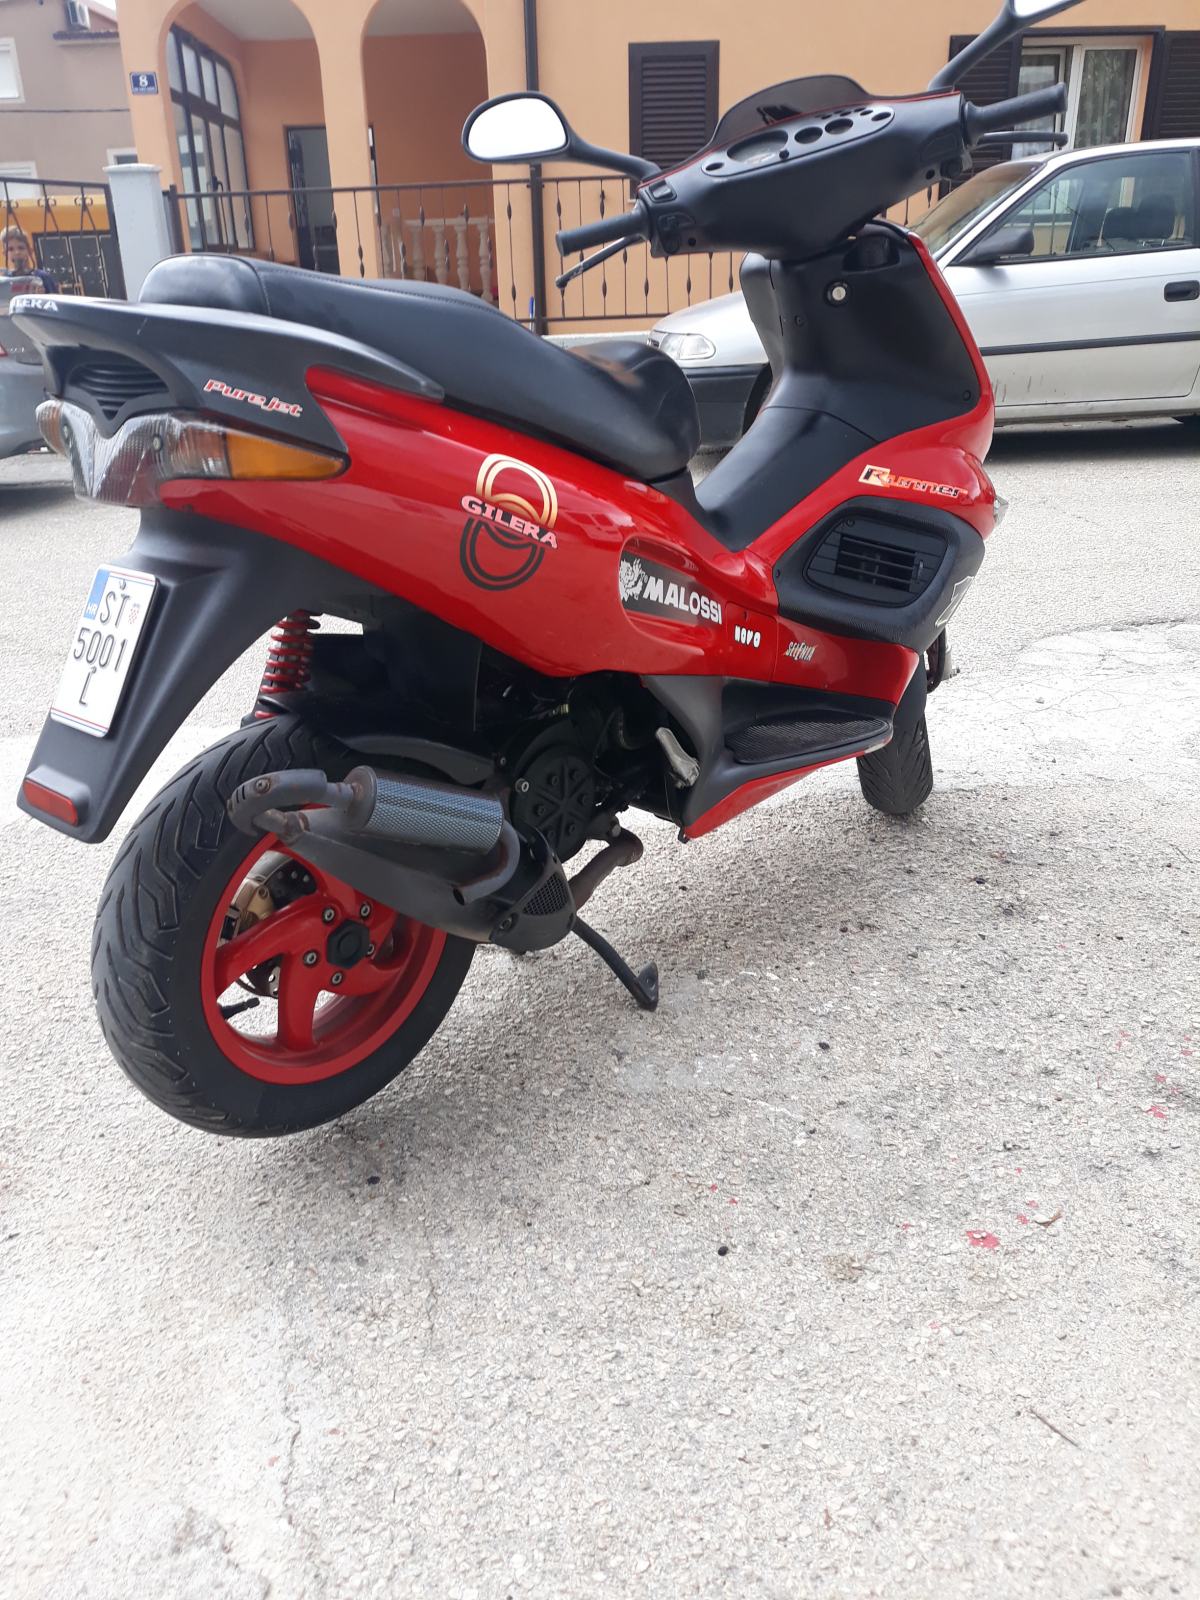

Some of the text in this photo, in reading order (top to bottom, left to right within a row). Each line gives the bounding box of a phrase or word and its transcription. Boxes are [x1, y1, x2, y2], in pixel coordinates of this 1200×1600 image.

[139, 74, 148, 87] 8
[461, 495, 558, 549] GILERA
[86, 603, 97, 615] HR
[100, 591, 130, 628] ST
[642, 575, 722, 624] MALOSSI
[74, 627, 126, 672] 5001
[79, 670, 93, 705] L
